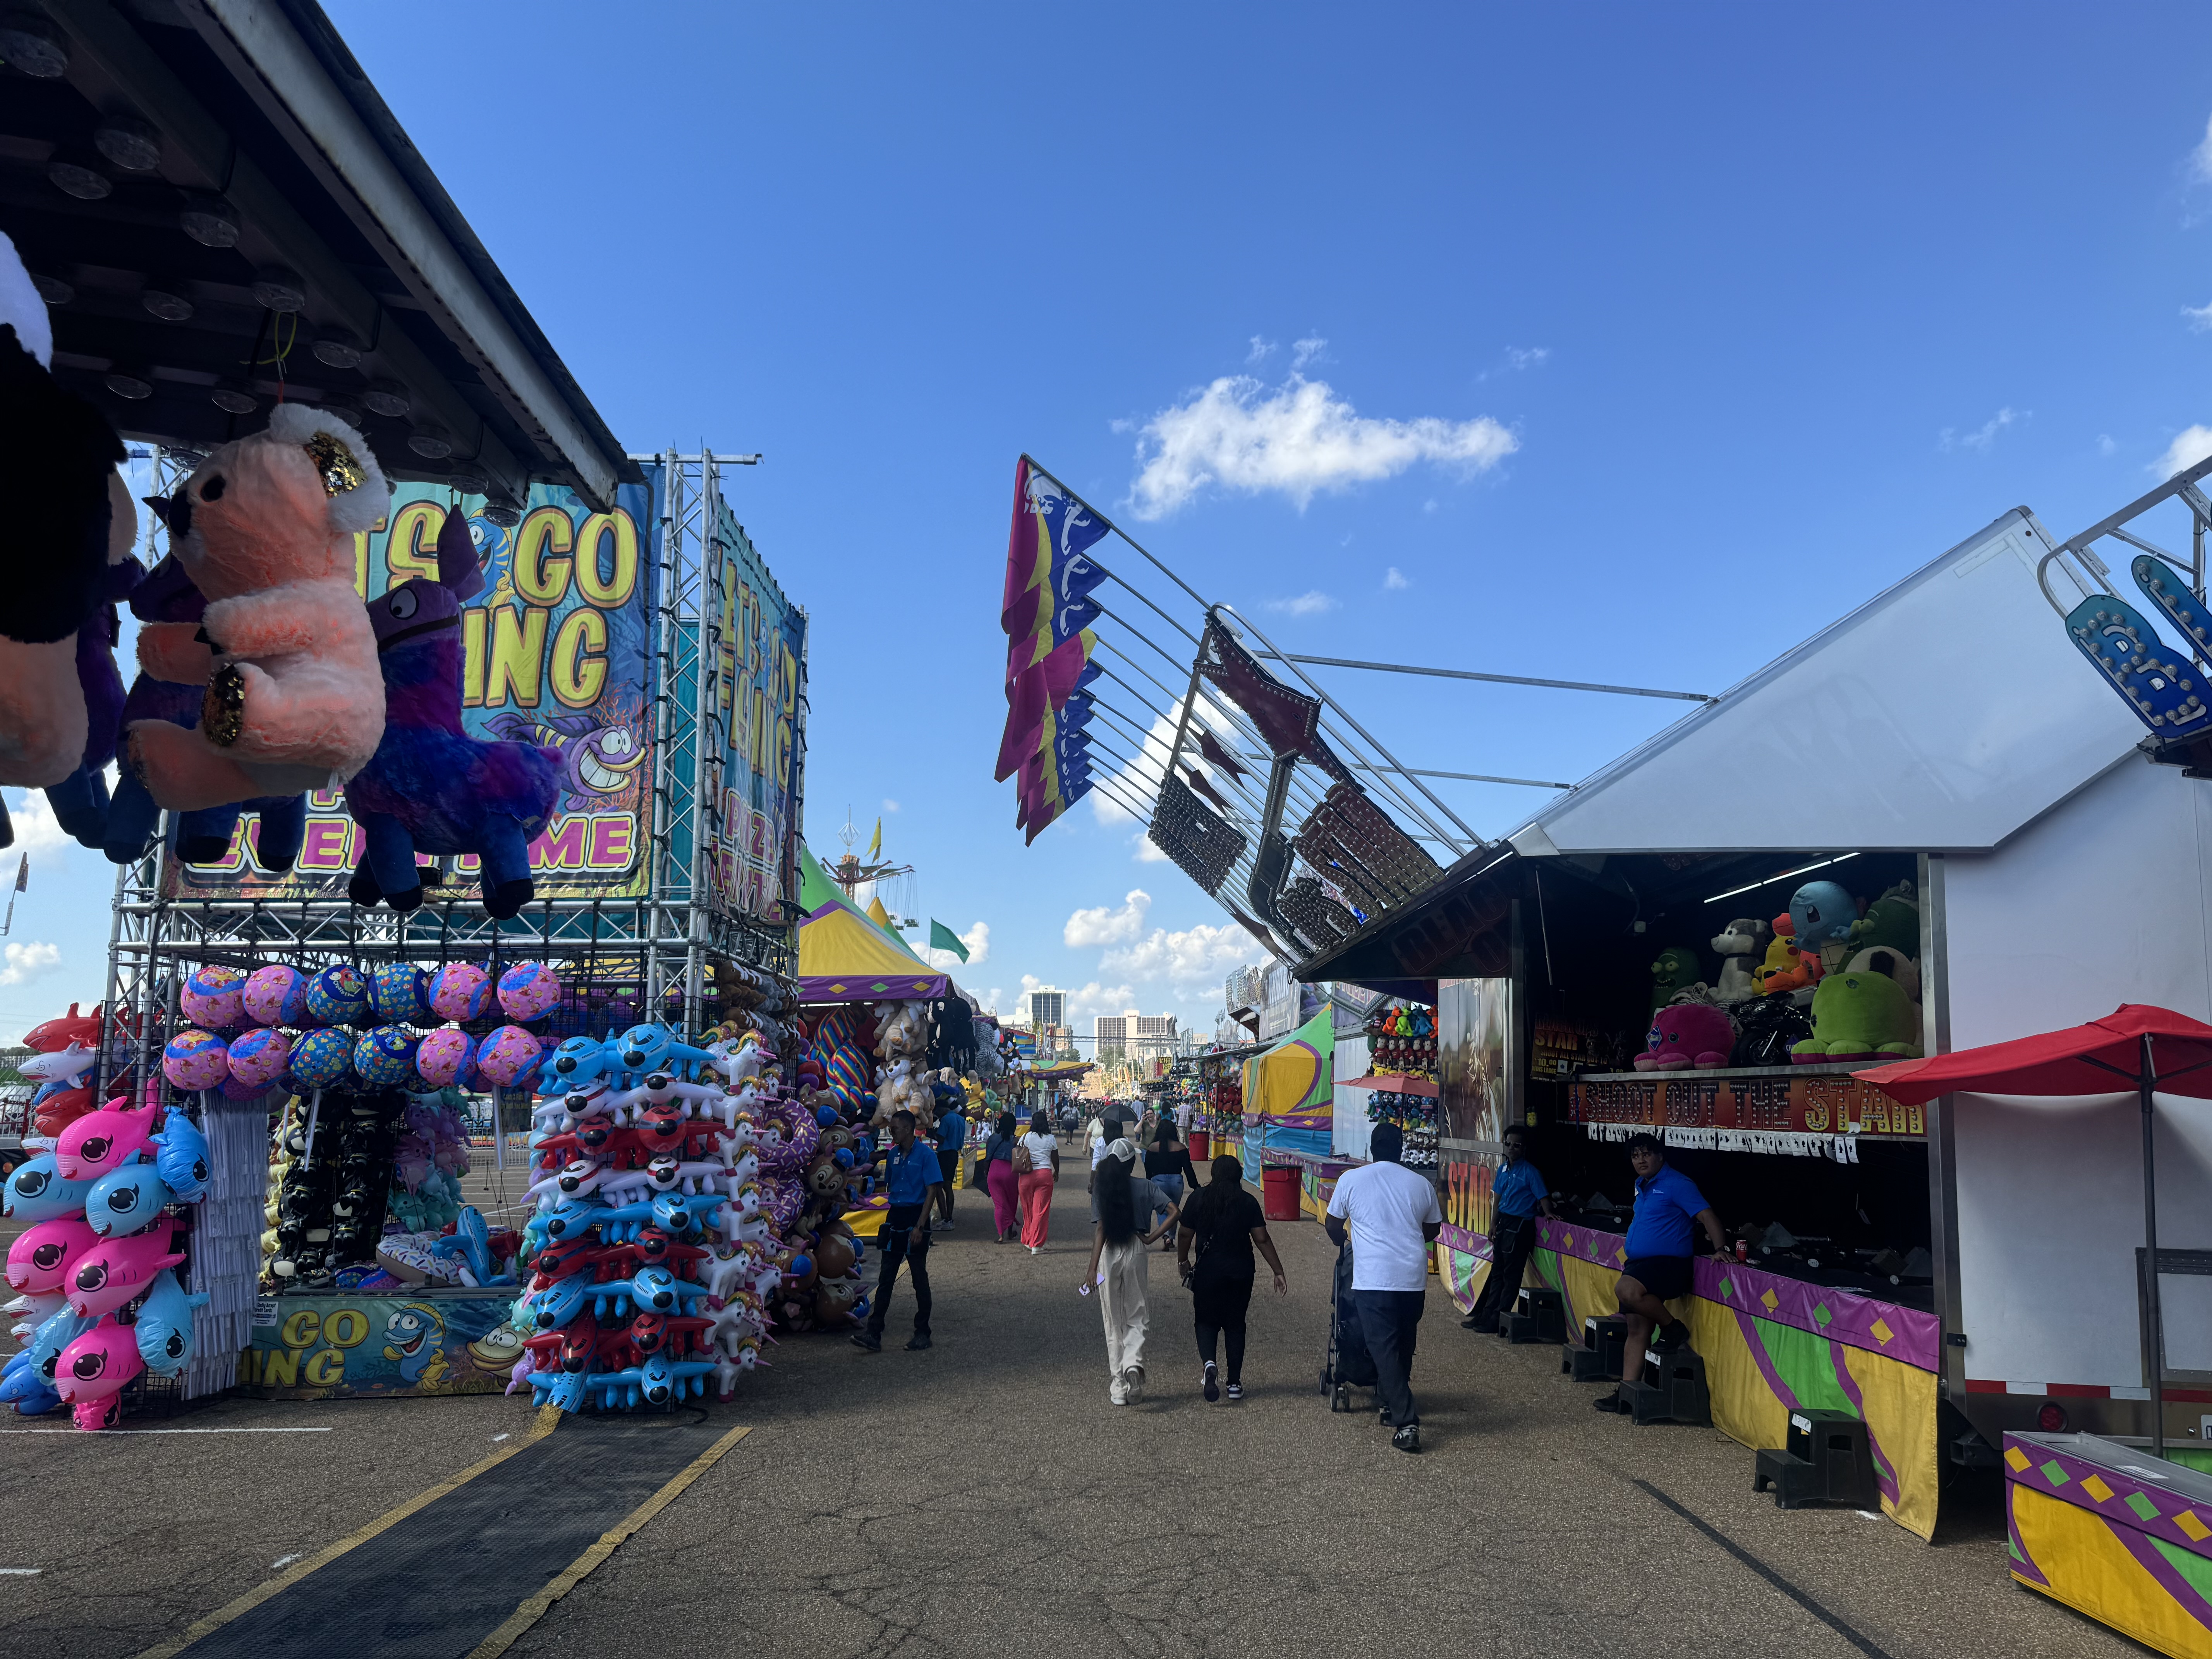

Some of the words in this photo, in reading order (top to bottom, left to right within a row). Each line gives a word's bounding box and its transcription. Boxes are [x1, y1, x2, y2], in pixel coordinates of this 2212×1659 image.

[511, 504, 640, 611] GO
[462, 603, 608, 710] ING
[1535, 1030, 1578, 1050] STAR
[1540, 1050, 1558, 1058] SHOOT
[1559, 1050, 1570, 1060] ALL
[1571, 1053, 1586, 1062] STAR
[1585, 1082, 1657, 1124] SHOOT
[1665, 1080, 1720, 1127] OUT
[1729, 1078, 1793, 1130] THE
[1803, 1077, 1925, 1137] STAR
[1447, 1161, 1491, 1237] STAR
[281, 1308, 370, 1348] GO
[241, 1348, 345, 1388] ING
